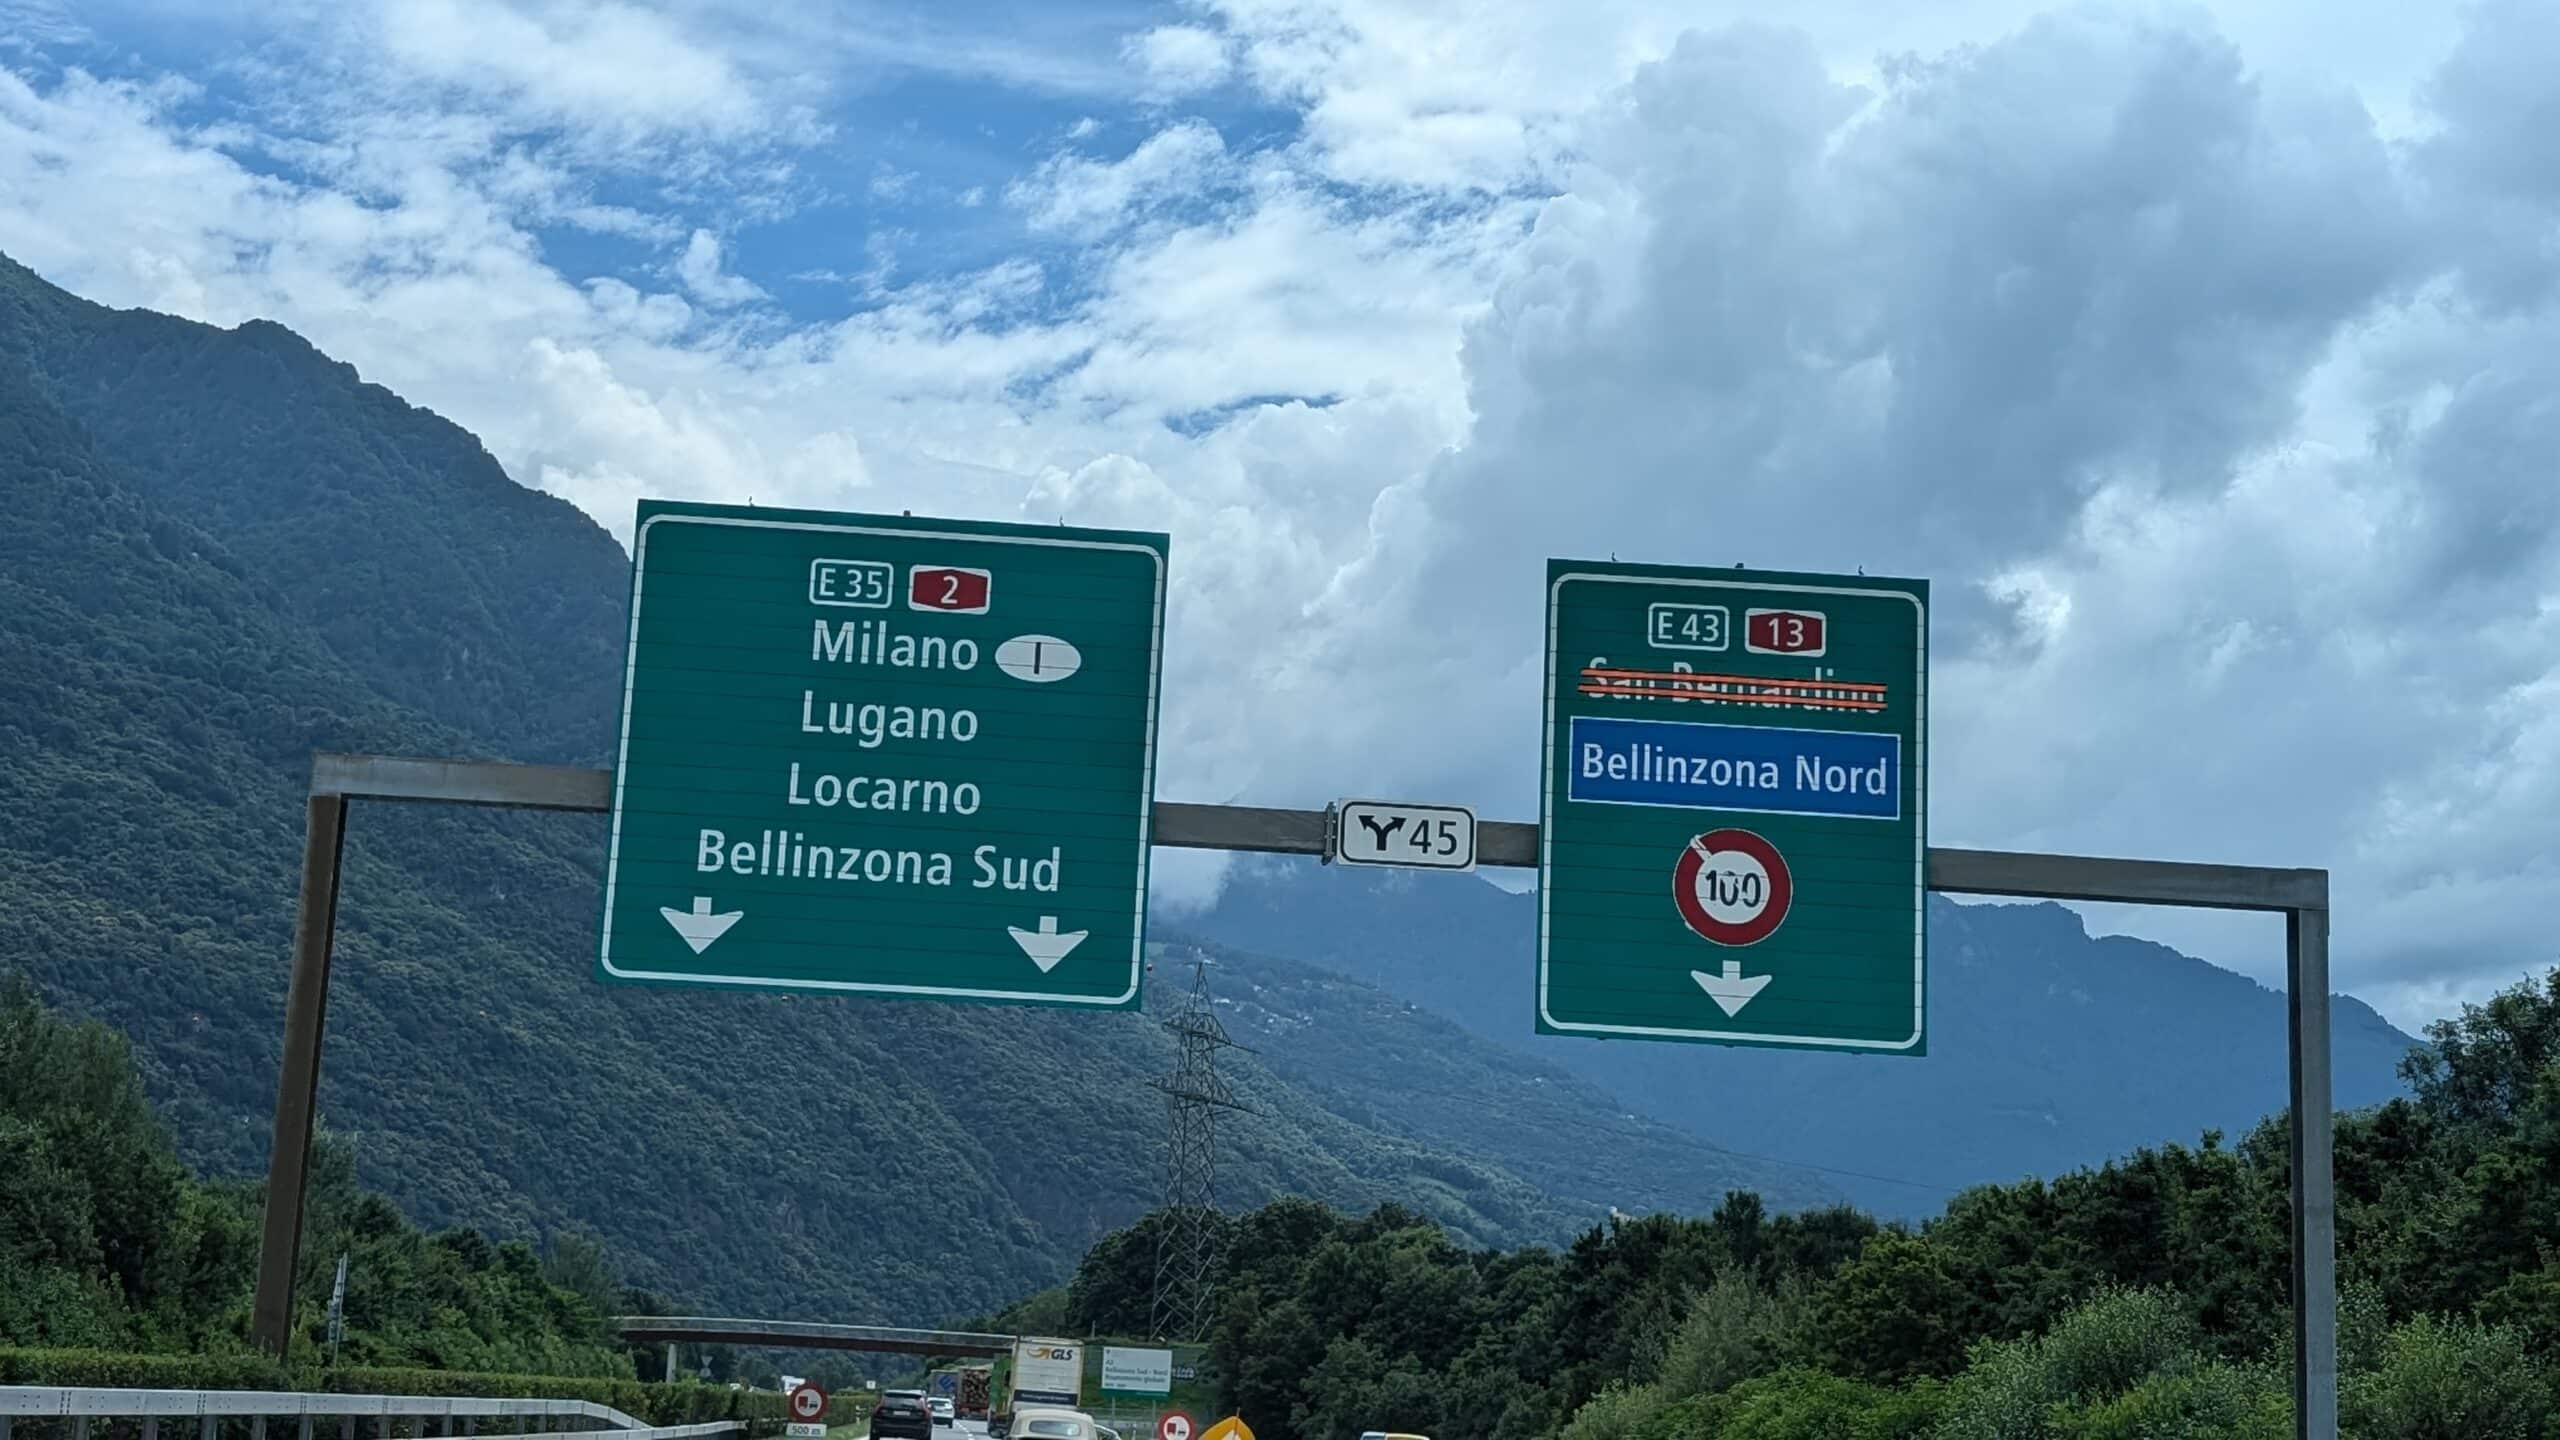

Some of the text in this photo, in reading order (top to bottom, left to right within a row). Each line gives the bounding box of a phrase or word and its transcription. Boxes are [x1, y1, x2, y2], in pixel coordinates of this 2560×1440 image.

[820, 567, 883, 599] E 35
[940, 576, 959, 604] 2
[1658, 611, 1719, 642] E 43
[1768, 617, 1804, 647] 13
[812, 619, 979, 671] Milano
[1033, 641, 1042, 675] I
[802, 690, 978, 748] Lugano
[1582, 743, 1887, 796] Bellinzona Nord
[788, 762, 981, 815] Locarno
[1409, 819, 1458, 857] 45
[697, 828, 1061, 892] Bellinzona Sud
[1705, 869, 1762, 908] 100
[1051, 1348, 1073, 1361] GLS
[792, 1425, 809, 1435] 500
